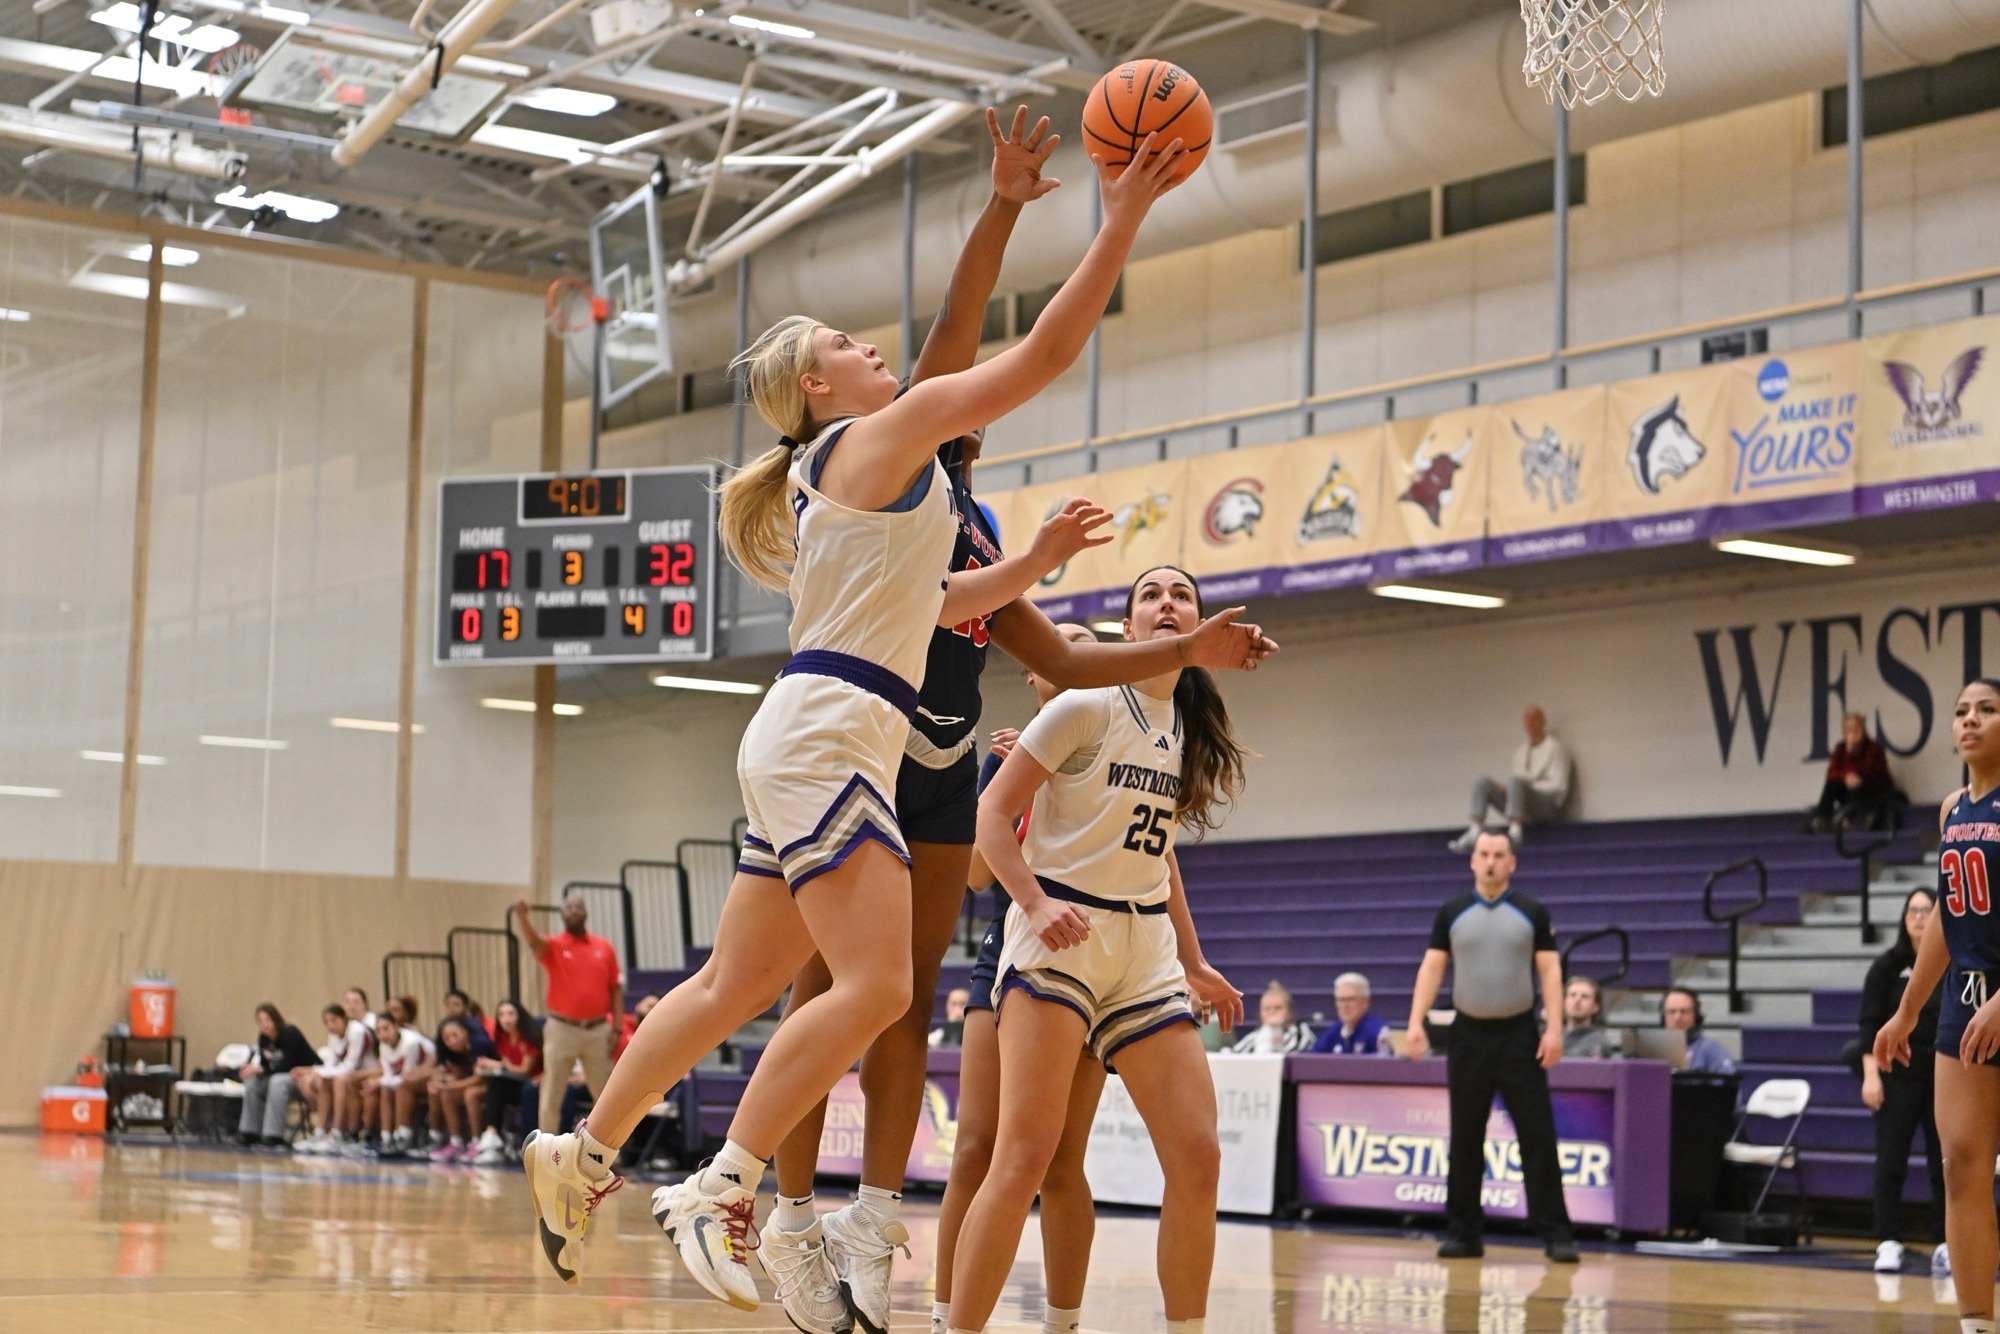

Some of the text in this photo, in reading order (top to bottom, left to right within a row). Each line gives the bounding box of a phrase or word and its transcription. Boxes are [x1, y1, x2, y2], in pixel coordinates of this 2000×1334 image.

[1778, 393, 1857, 424] MAKE IT
[1729, 413, 1855, 493] YOURS
[549, 478, 624, 516] 9:01
[1884, 480, 1977, 509] WESTMINSTER
[459, 527, 505, 549] HOME
[639, 520, 691, 542] GUEST
[478, 551, 509, 588] 17
[565, 551, 582, 585] 3
[650, 543, 694, 586] 32
[462, 608, 480, 641] 0
[503, 607, 519, 640] 3
[624, 605, 644, 634] 4
[673, 602, 692, 636] 0
[1107, 762, 1181, 800] WESTMINS
[1122, 803, 1173, 857] 25
[1941, 847, 1990, 916] 30
[1316, 1122, 1611, 1187] WESTMNSER
[1395, 1182, 1519, 1208] GRINS
